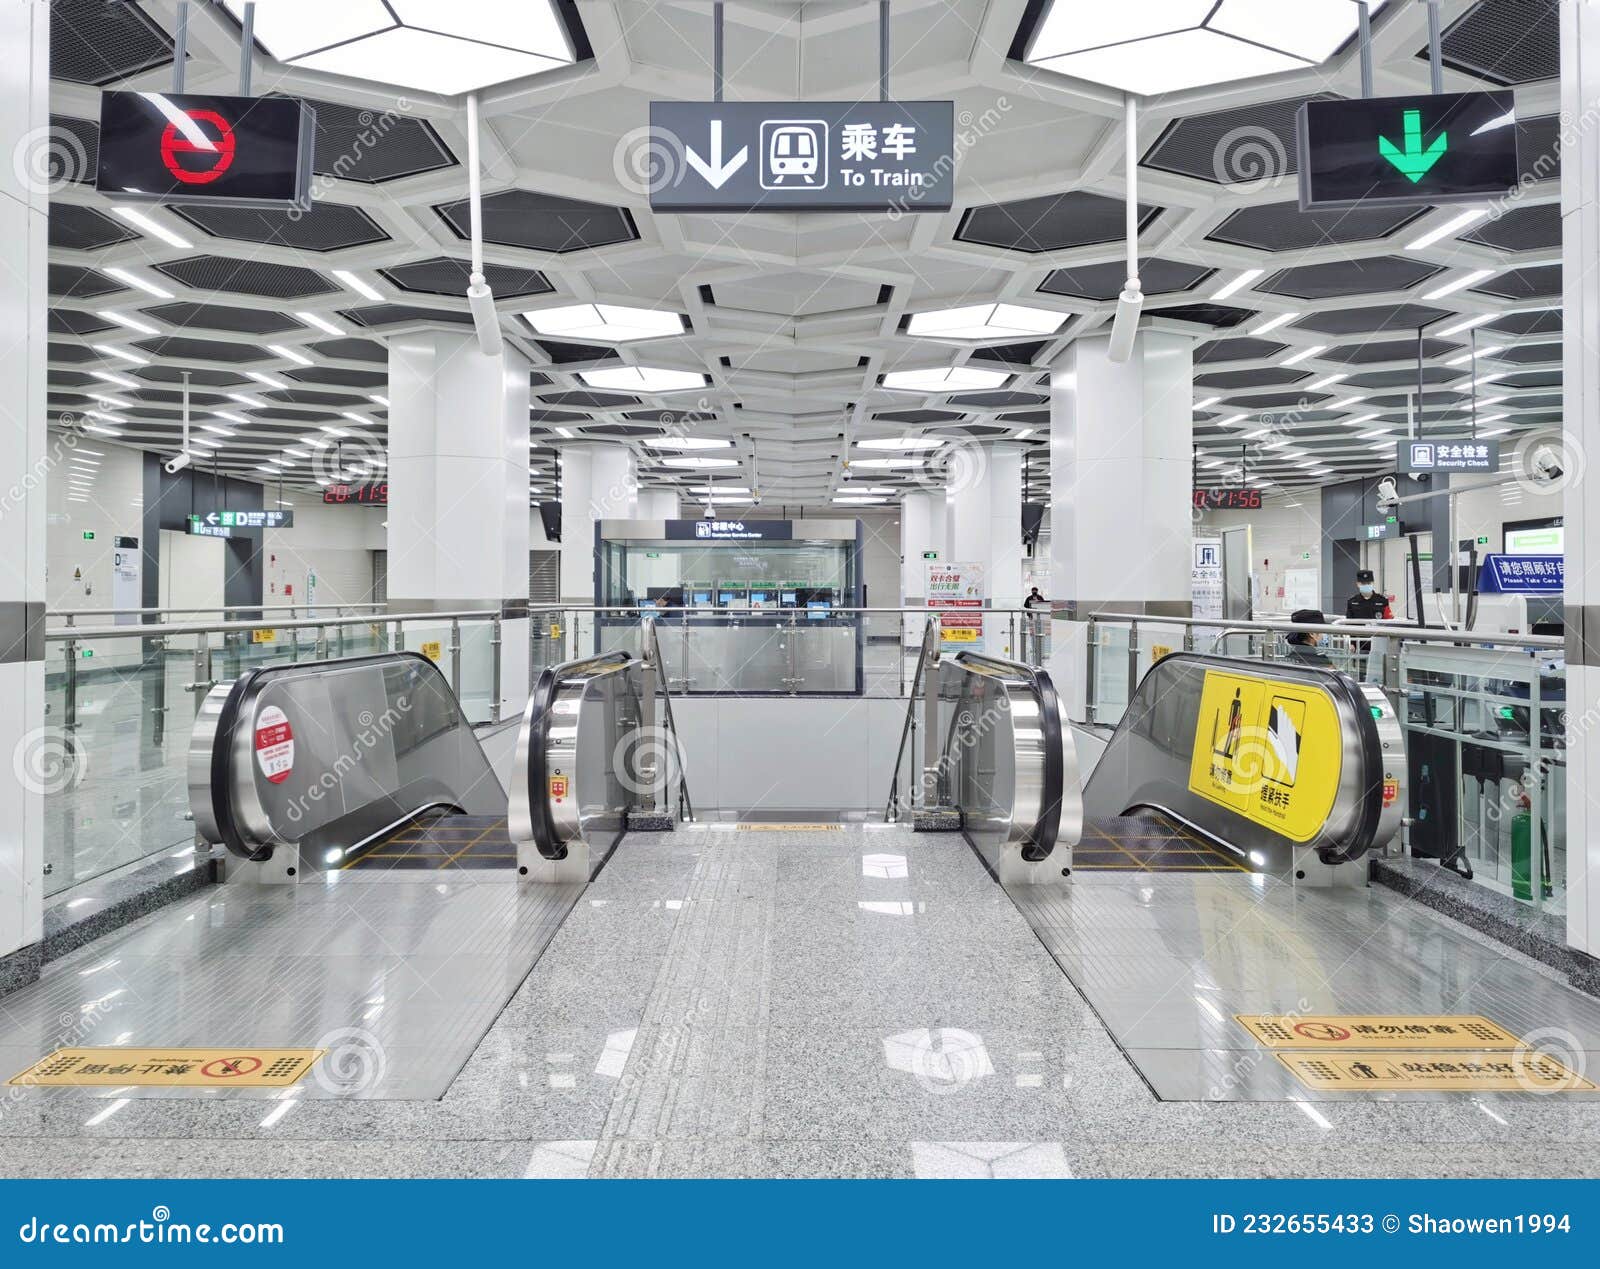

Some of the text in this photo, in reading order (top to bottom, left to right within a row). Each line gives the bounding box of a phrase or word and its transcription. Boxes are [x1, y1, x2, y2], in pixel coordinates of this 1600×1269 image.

[841, 123, 916, 161] 乘车
[840, 169, 922, 186] To Train
[1437, 445, 1488, 458] 安全检查
[236, 512, 247, 526] D
[1350, 1024, 1459, 1034] 请勿倚靠
